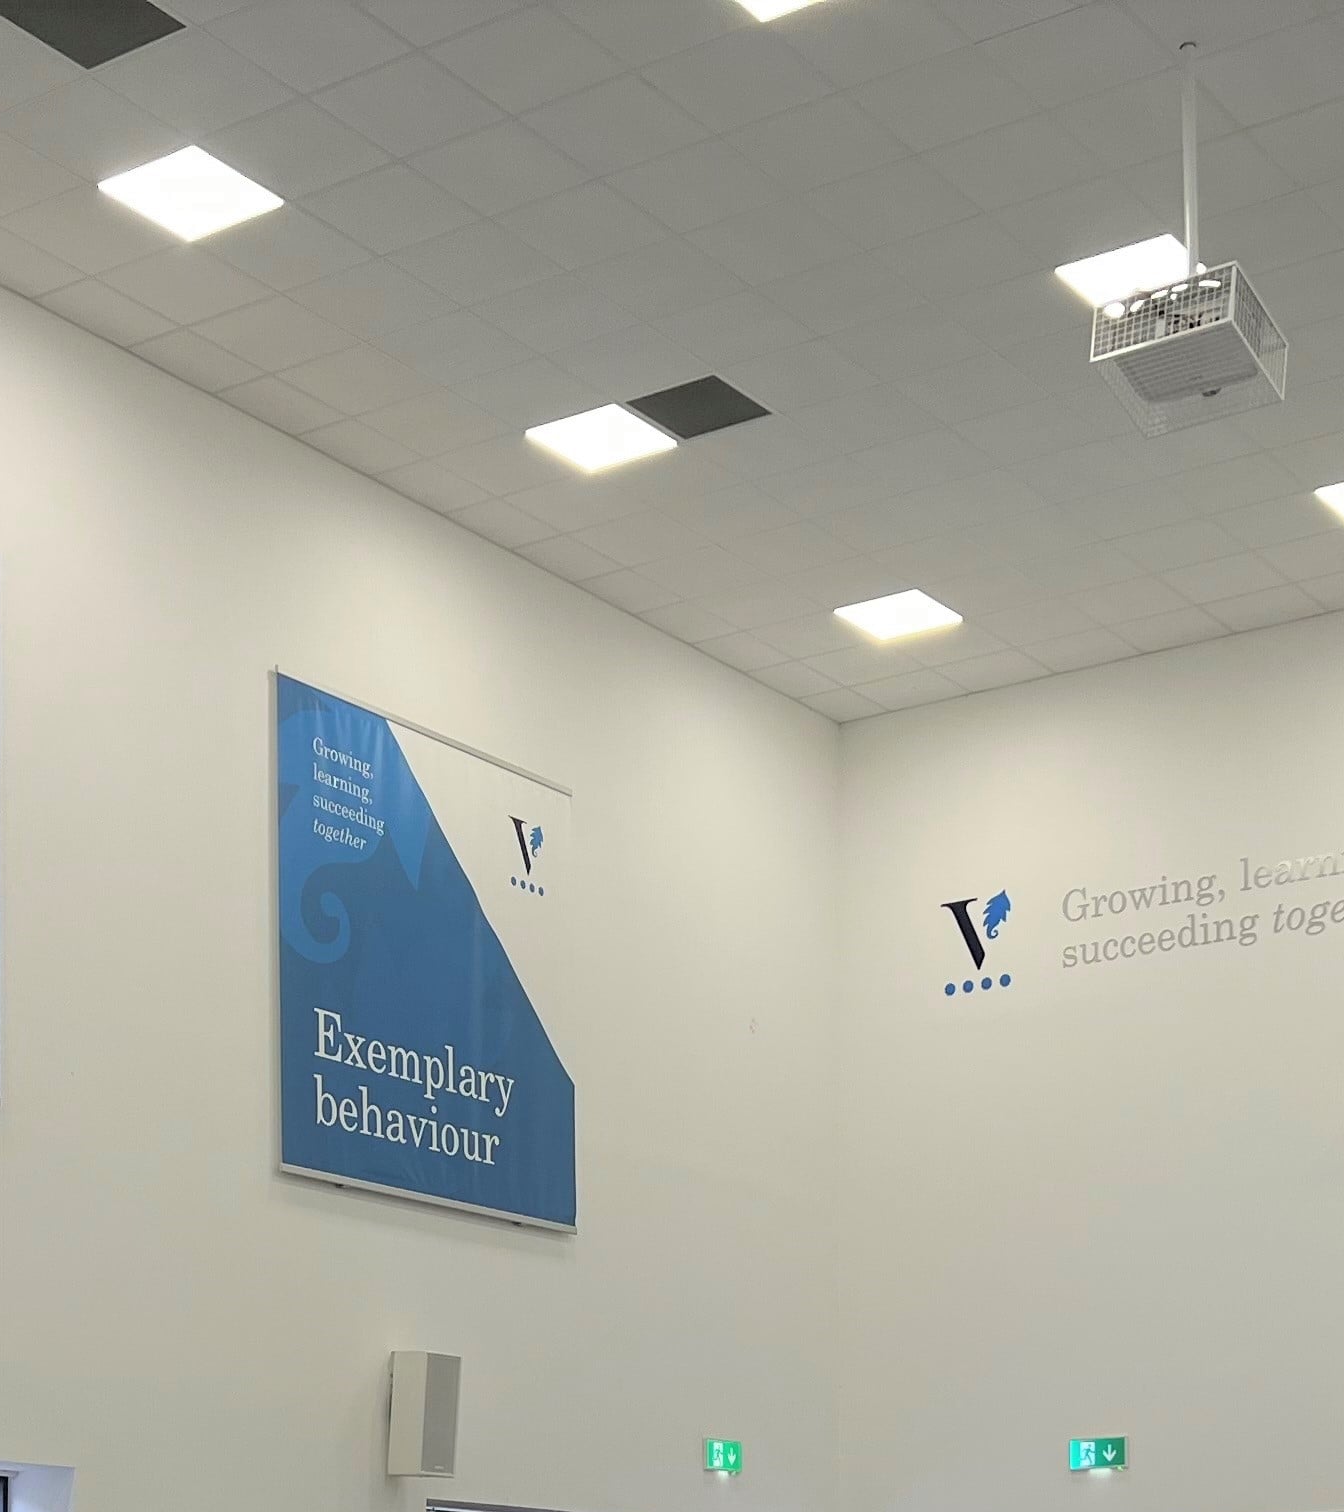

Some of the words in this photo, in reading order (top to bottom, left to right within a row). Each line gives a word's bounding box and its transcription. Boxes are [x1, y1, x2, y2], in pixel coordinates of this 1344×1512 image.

[312, 736, 374, 780] Growing,
[312, 762, 373, 806] learning,
[312, 794, 385, 837] succeeding
[312, 818, 367, 850] together
[1062, 874, 1226, 922] Growing,
[1062, 912, 1260, 968] succeeding
[313, 1007, 515, 1118] Exemplary
[313, 1073, 500, 1166] behaviour
